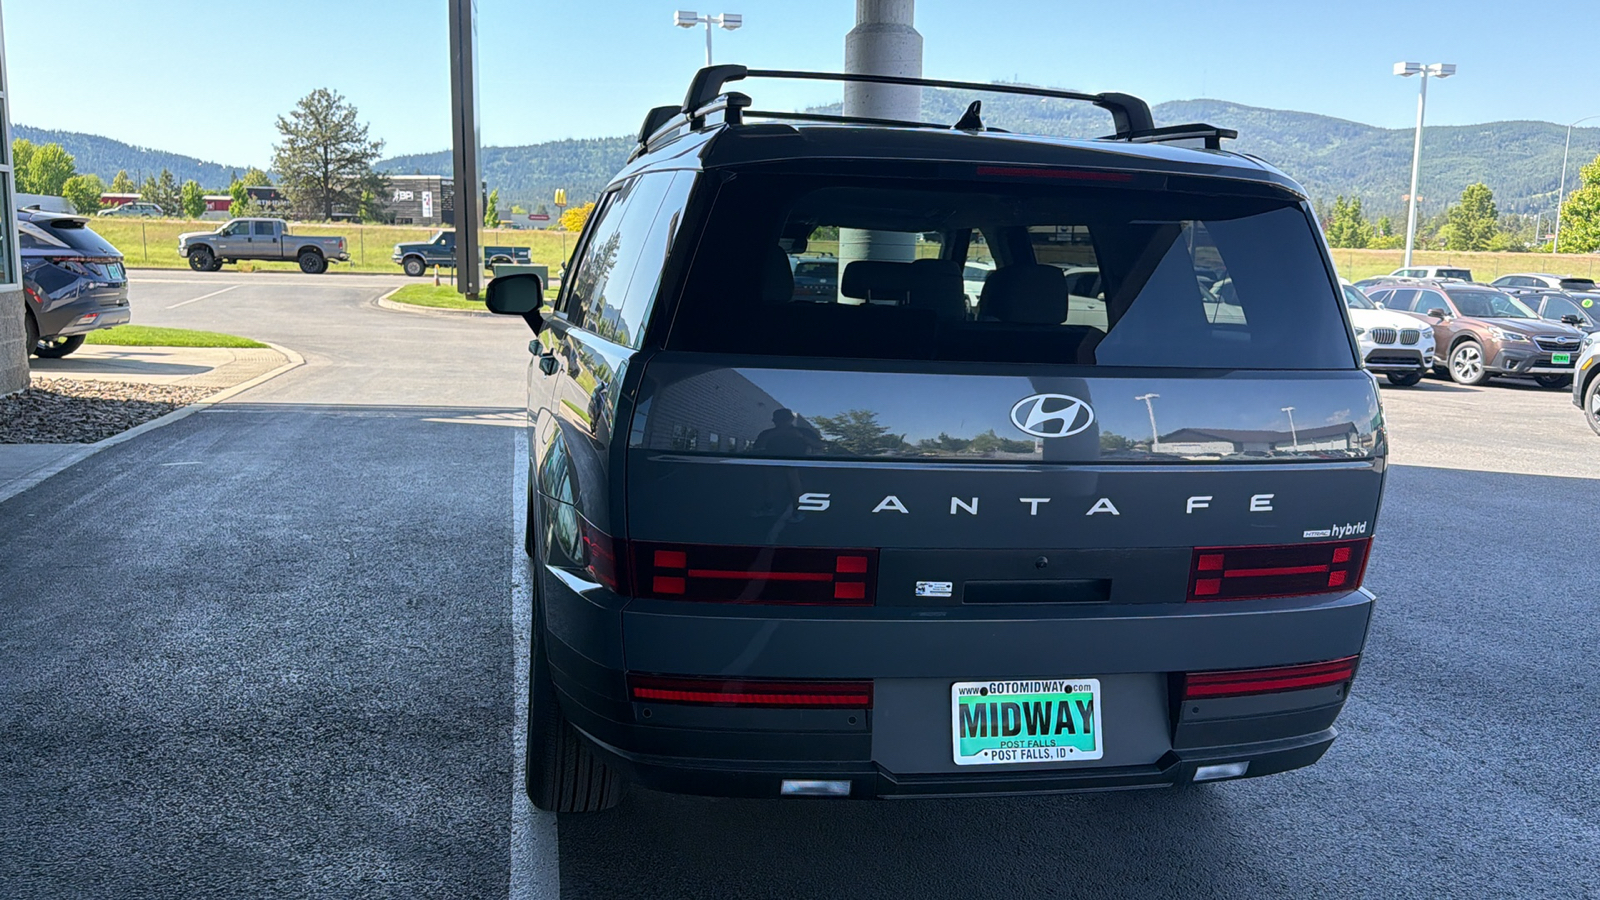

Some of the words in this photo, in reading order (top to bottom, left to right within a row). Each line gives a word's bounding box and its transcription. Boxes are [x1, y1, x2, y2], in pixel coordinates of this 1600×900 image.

[797, 492, 1120, 516] SANTA
[1185, 493, 1275, 515] FE
[1331, 521, 1367, 539] hybrid
[958, 700, 1094, 738] MIDWAY
[1000, 740, 1025, 749] POST
[1027, 739, 1056, 748] FALLS
[991, 749, 1017, 761] POST
[1020, 748, 1054, 760] FALLS,
[1056, 747, 1067, 759] ID
